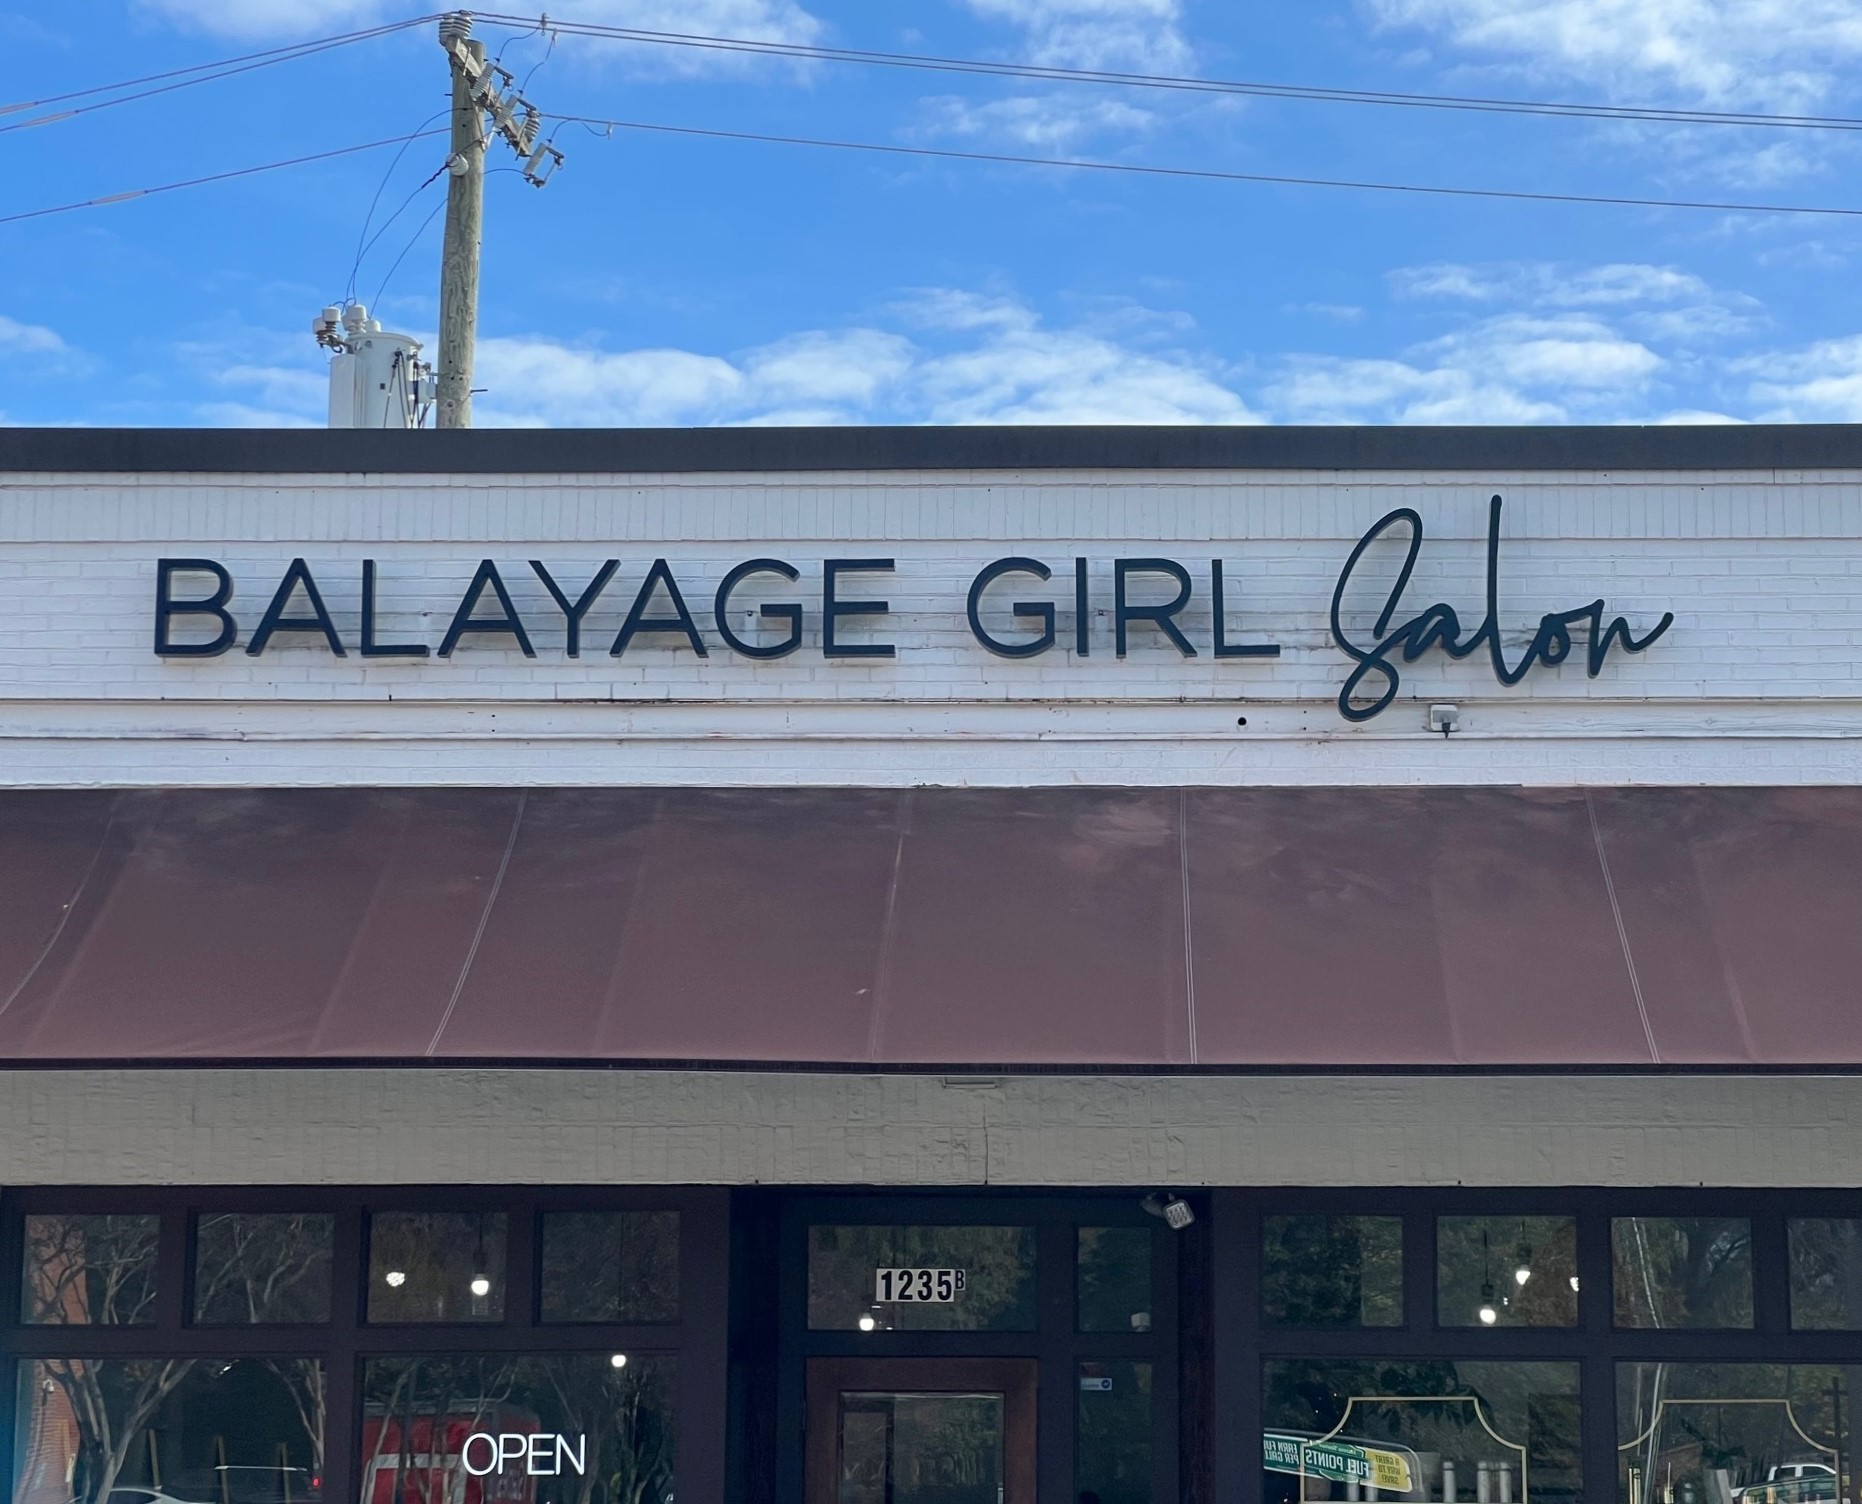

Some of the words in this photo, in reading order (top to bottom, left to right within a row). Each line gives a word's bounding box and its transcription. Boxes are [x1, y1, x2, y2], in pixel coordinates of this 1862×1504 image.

[153, 558, 896, 659] BALAYAGE
[966, 556, 1281, 659] GIRL
[1330, 494, 1675, 722] Salon
[462, 1433, 586, 1476] OPEN
